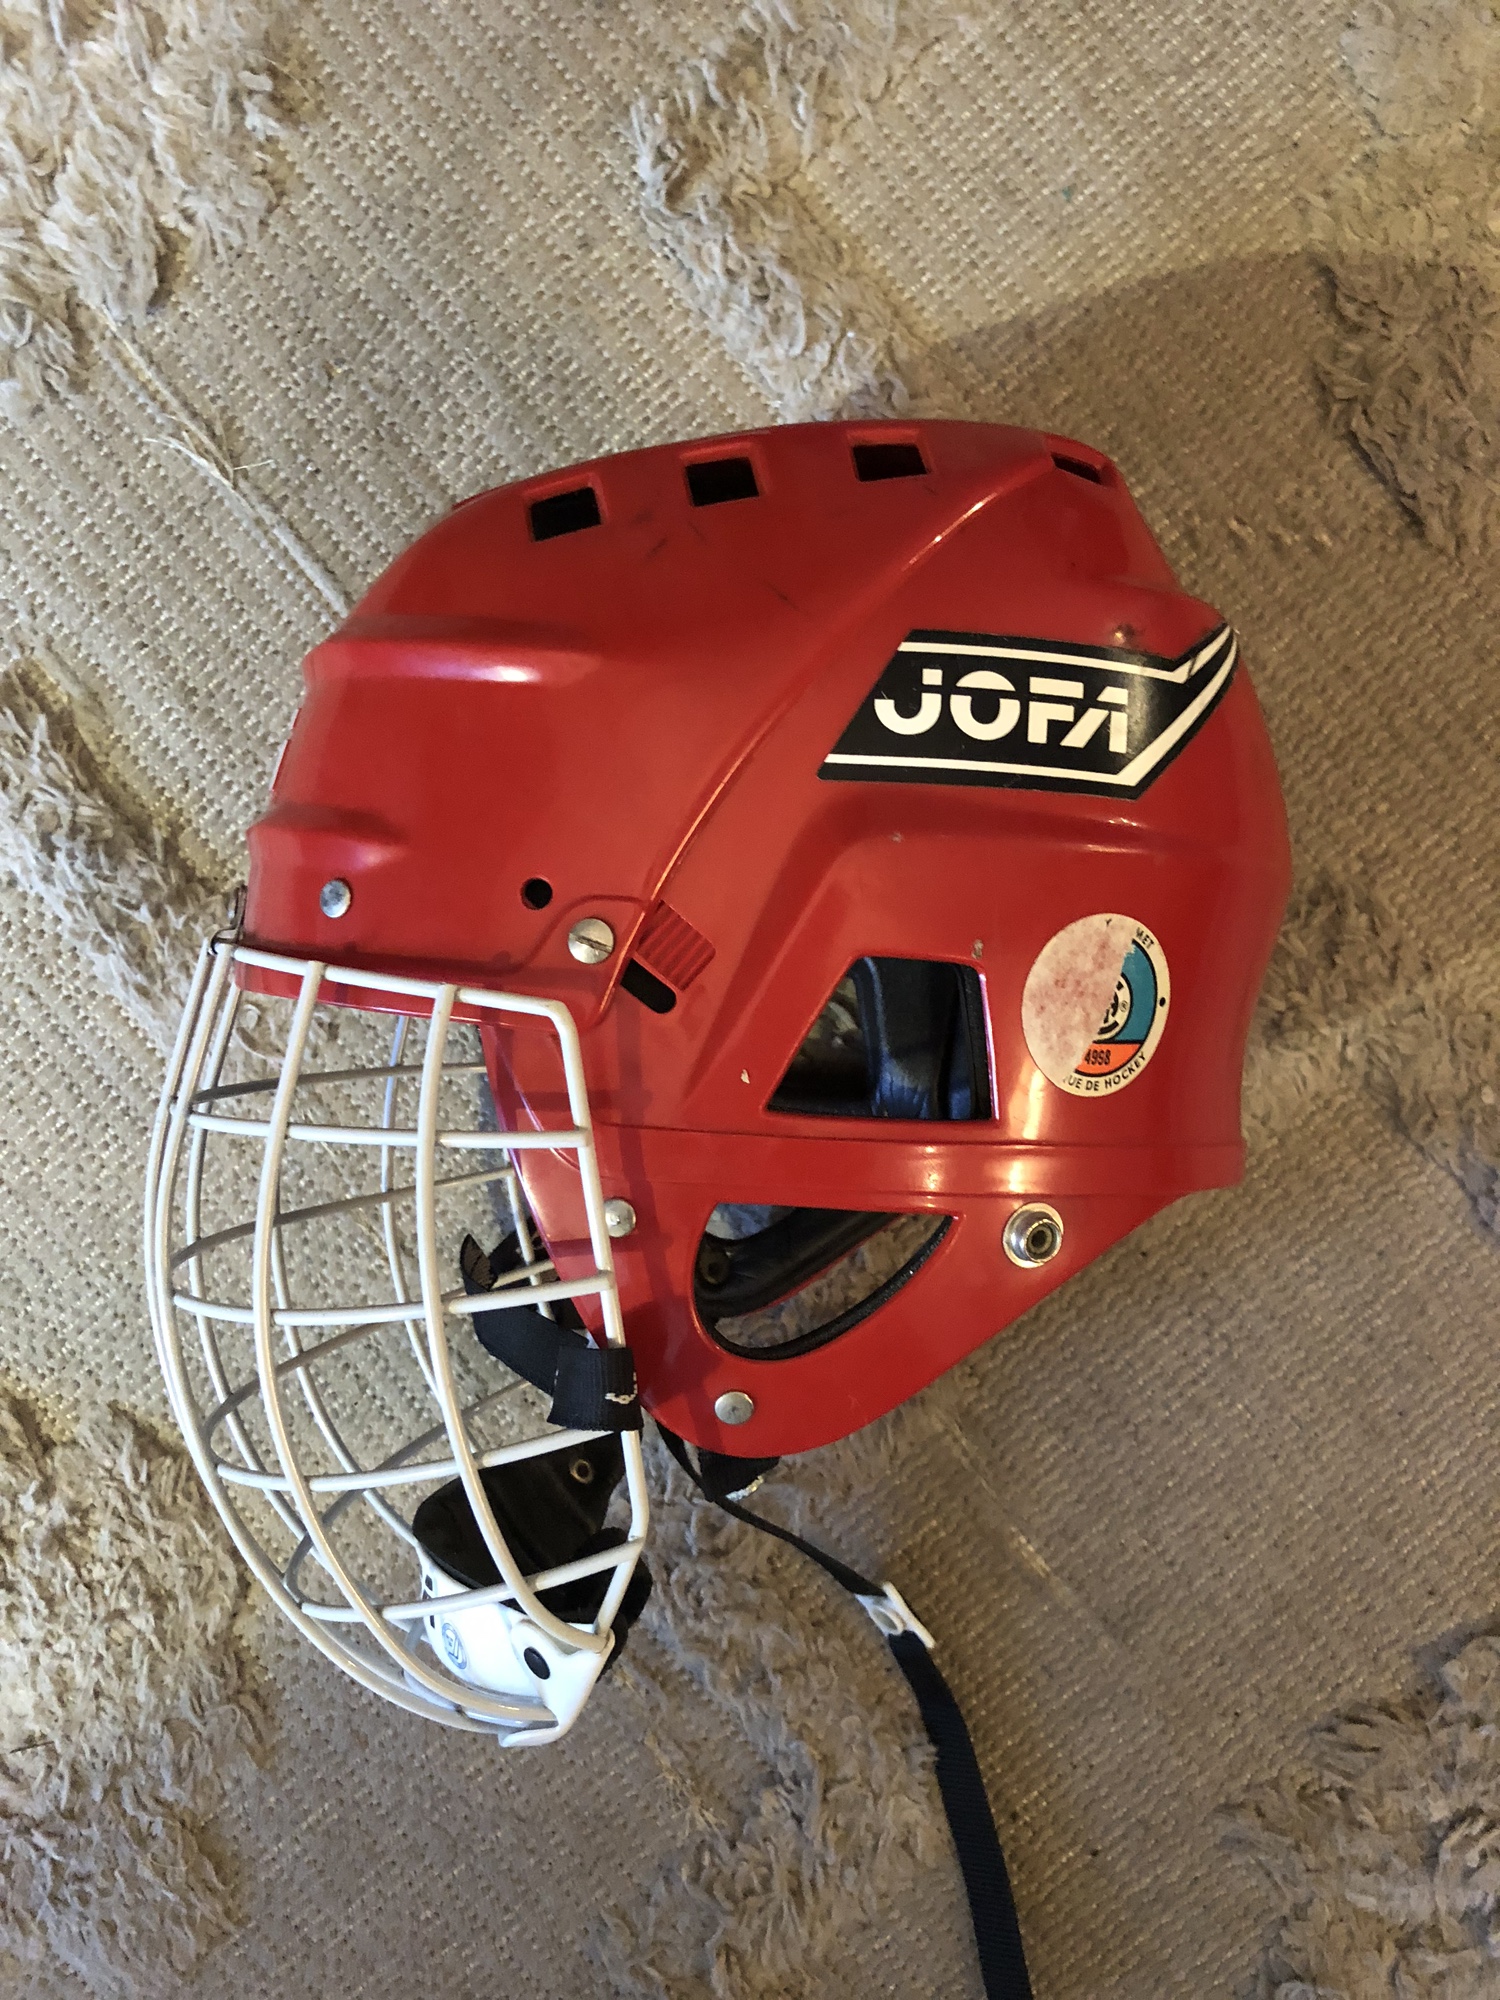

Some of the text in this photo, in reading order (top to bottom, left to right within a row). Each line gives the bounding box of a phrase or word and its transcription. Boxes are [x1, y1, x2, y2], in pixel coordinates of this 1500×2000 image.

[874, 668, 1128, 754] JOFA
[1063, 1051, 1146, 1091] UE DE HOCKEY
